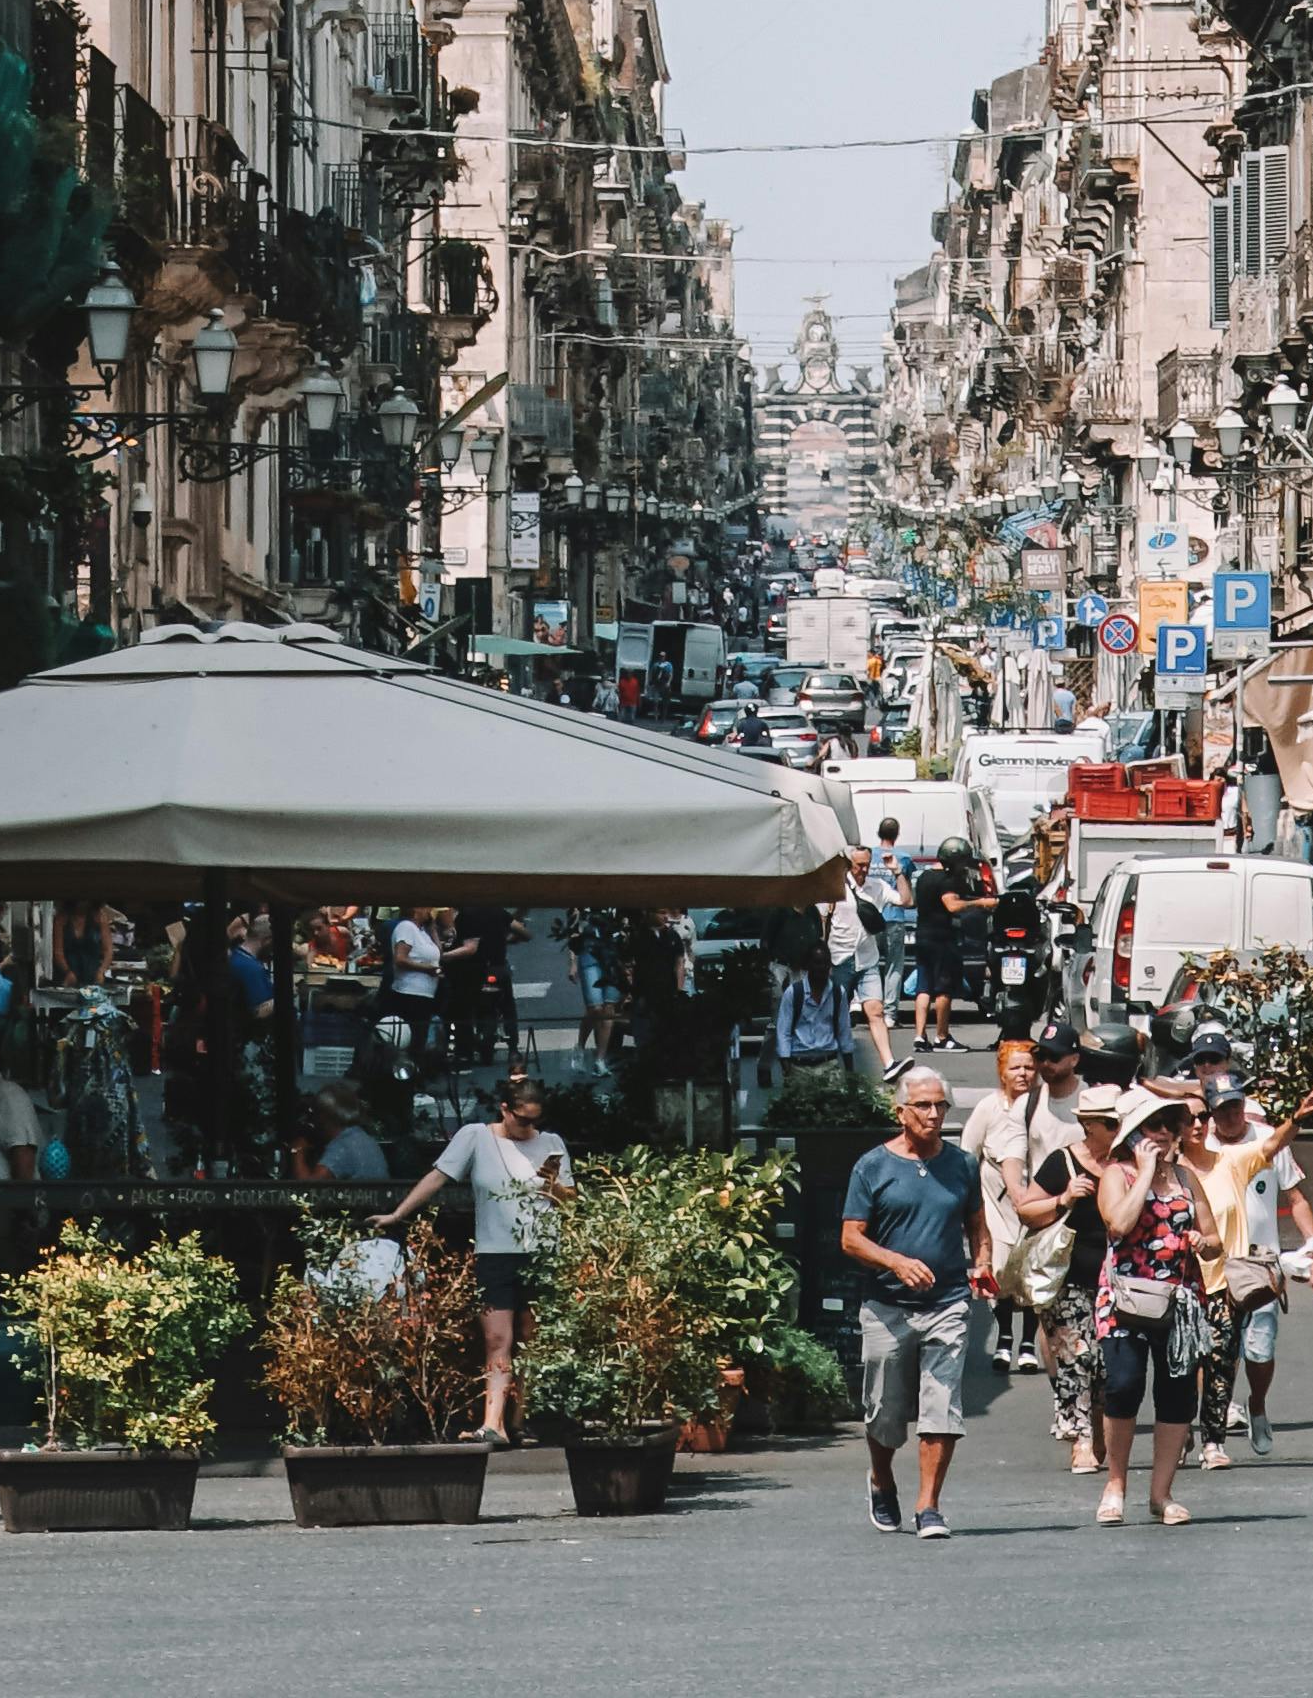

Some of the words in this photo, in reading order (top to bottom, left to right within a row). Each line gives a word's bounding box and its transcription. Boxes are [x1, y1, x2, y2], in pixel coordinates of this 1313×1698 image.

[1225, 580, 1257, 622] P
[1038, 619, 1058, 646] P
[1166, 629, 1197, 670] P
